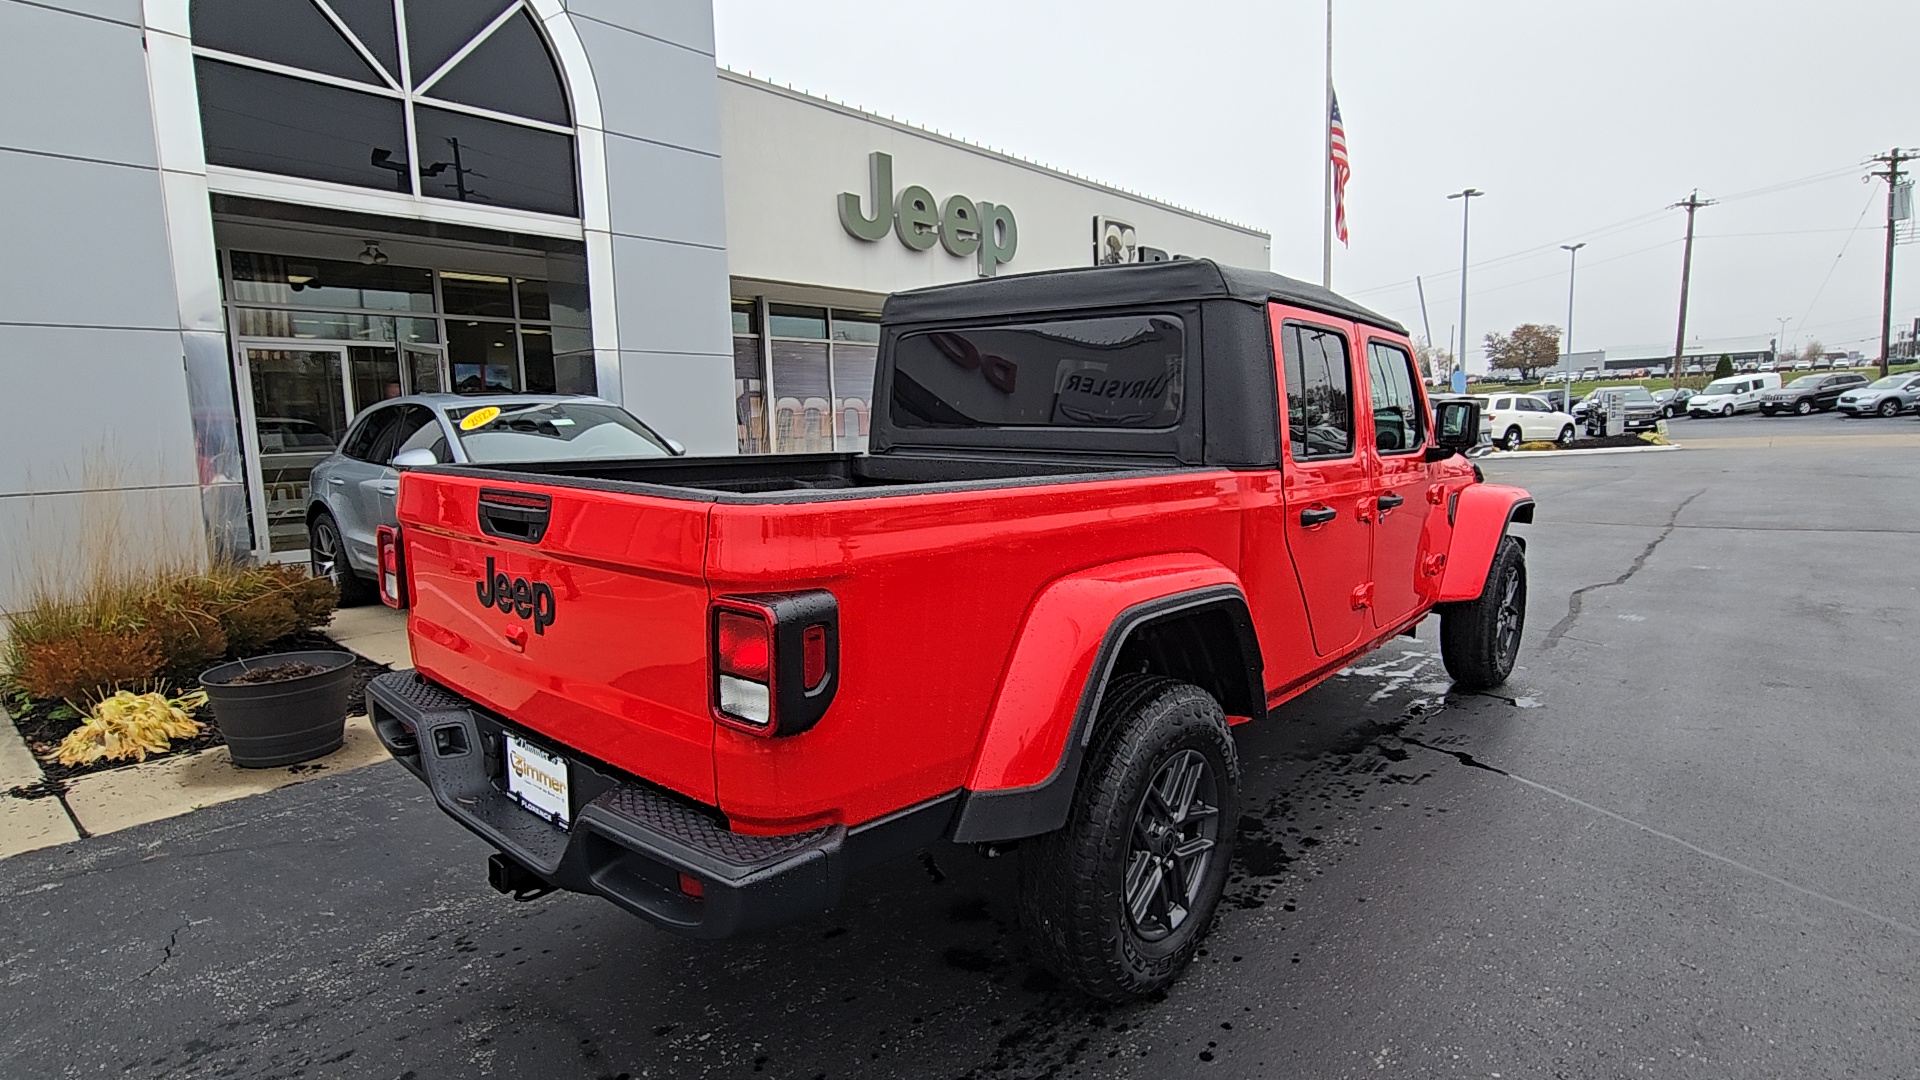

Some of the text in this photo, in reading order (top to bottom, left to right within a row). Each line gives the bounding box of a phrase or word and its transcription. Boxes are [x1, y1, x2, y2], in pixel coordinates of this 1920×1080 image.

[837, 151, 1018, 276] Jeep
[467, 409, 495, 427] 2022
[475, 555, 556, 636] Jeep
[512, 752, 566, 794] Zimmer
